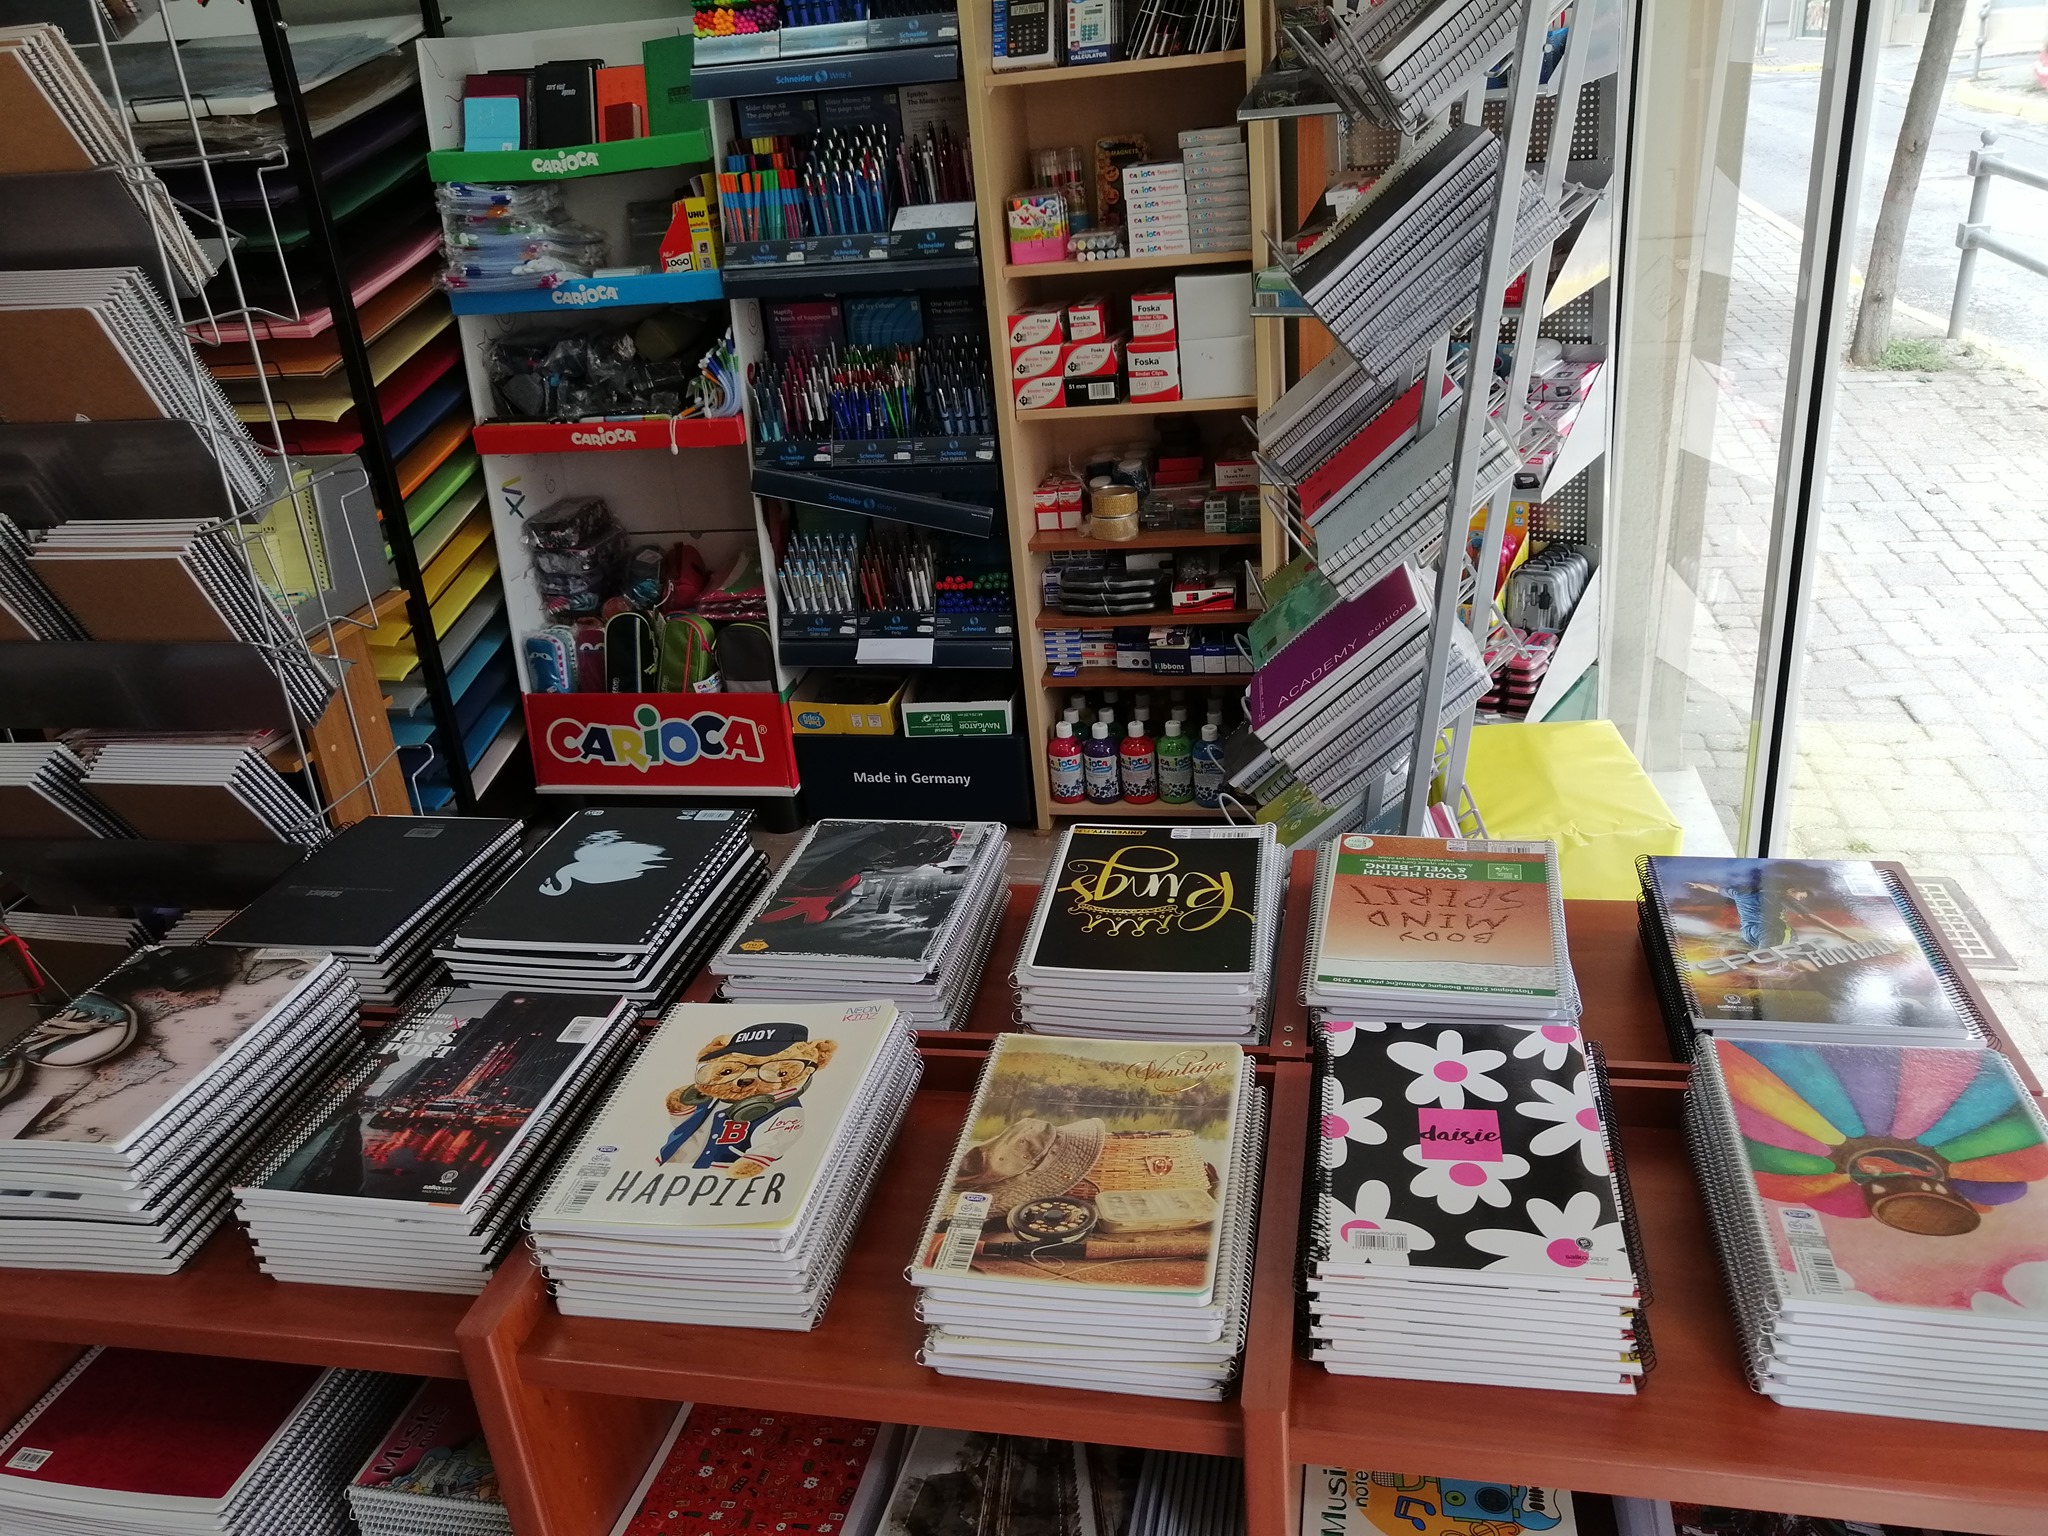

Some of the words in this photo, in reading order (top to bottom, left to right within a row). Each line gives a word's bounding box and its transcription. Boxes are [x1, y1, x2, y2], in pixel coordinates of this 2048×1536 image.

[1070, 51, 1107, 61] CALCULATOR
[776, 73, 813, 85] Schneider
[829, 71, 846, 80] Write
[907, 91, 928, 99] Epsilon
[758, 111, 773, 120] page
[687, 210, 705, 219] UHU
[918, 241, 945, 250] Schneider
[752, 253, 778, 261] Schneider
[834, 249, 861, 257] Schneider
[667, 258, 690, 267] LOGO
[803, 313, 831, 322] happiness
[780, 454, 805, 462] Schneider
[859, 452, 885, 460] Schneider
[828, 492, 862, 507] Schneider
[1367, 603, 1407, 637] edition
[884, 624, 909, 632] Schneider
[961, 625, 987, 633] Schneider
[1276, 637, 1360, 708] ACADEMY
[940, 713, 951, 721] 80
[959, 722, 1000, 732] NAVIGATOR
[853, 771, 891, 783] Made
[895, 772, 907, 783] in
[910, 772, 971, 787] Germany
[1365, 862, 1453, 873] WELL-BEING
[1363, 868, 1420, 879] HEALTH
[1423, 870, 1468, 880] GOOD
[1057, 846, 1255, 932] Kings
[1350, 883, 1524, 910] SPIRIT
[1367, 910, 1510, 930] MIND
[1399, 931, 1495, 943] BODY
[1697, 937, 1827, 976] SPORT
[1806, 939, 1899, 968] FOOTBALL
[846, 1005, 881, 1015] NEON
[842, 1012, 879, 1022] KIDZ
[391, 1029, 458, 1045] PASS
[735, 1028, 777, 1043] ENJOY
[378, 1042, 457, 1059] PORT
[1125, 1049, 1228, 1093] Vintage
[765, 1117, 799, 1133] Love
[784, 1123, 803, 1133] me
[716, 1121, 750, 1144] B
[1419, 1125, 1501, 1144] daisie
[605, 1170, 787, 1207] HAPPIER
[373, 1403, 437, 1474] Music
[1320, 1466, 1348, 1536] Musi
